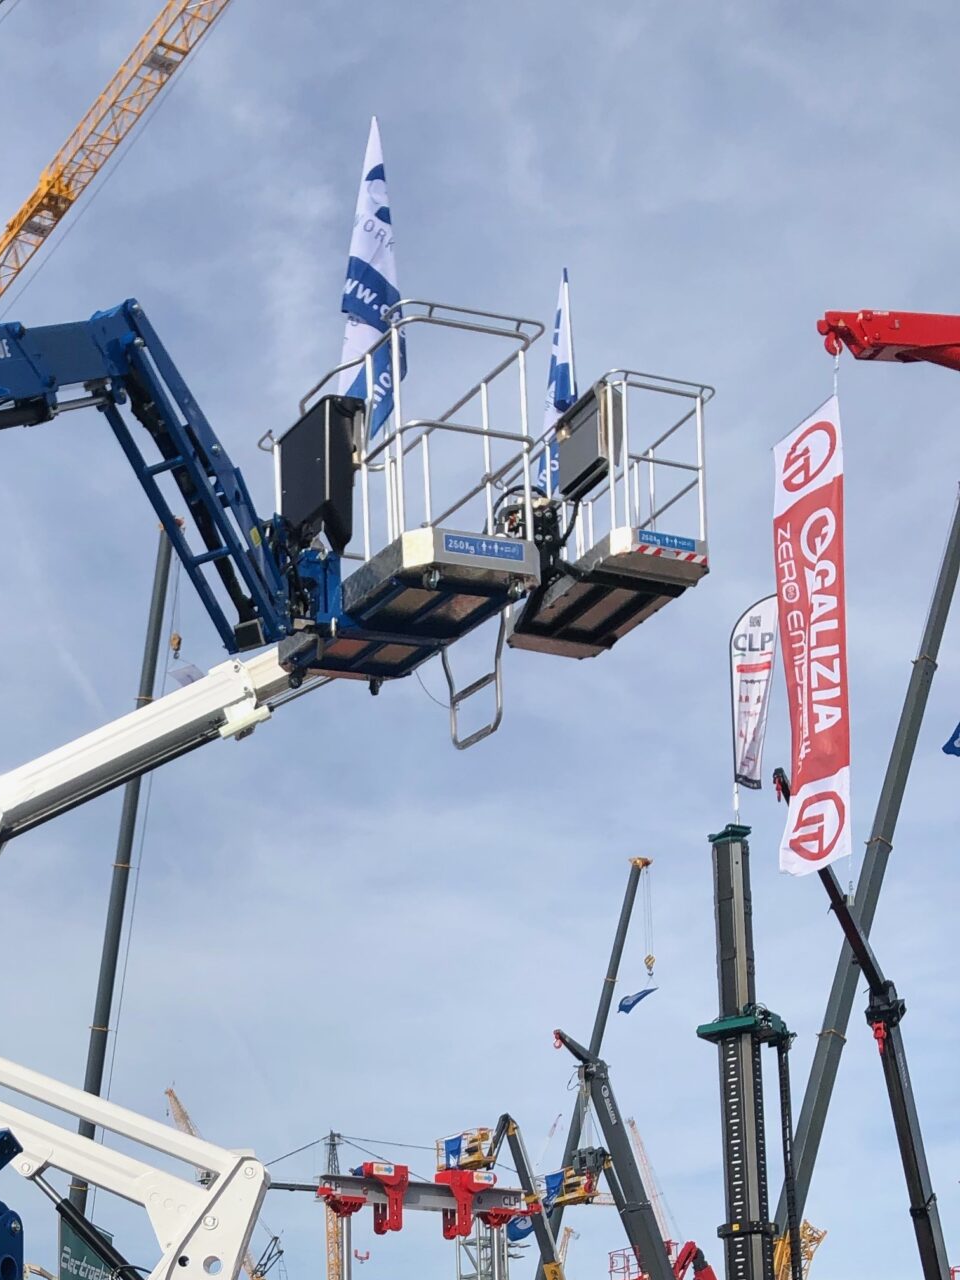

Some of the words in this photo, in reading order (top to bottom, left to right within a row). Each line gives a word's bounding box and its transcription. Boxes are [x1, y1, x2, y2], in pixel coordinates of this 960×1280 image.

[733, 632, 774, 652] CLP
[809, 559, 842, 733] GALIZIA
[502, 1196, 520, 1207] CLP
